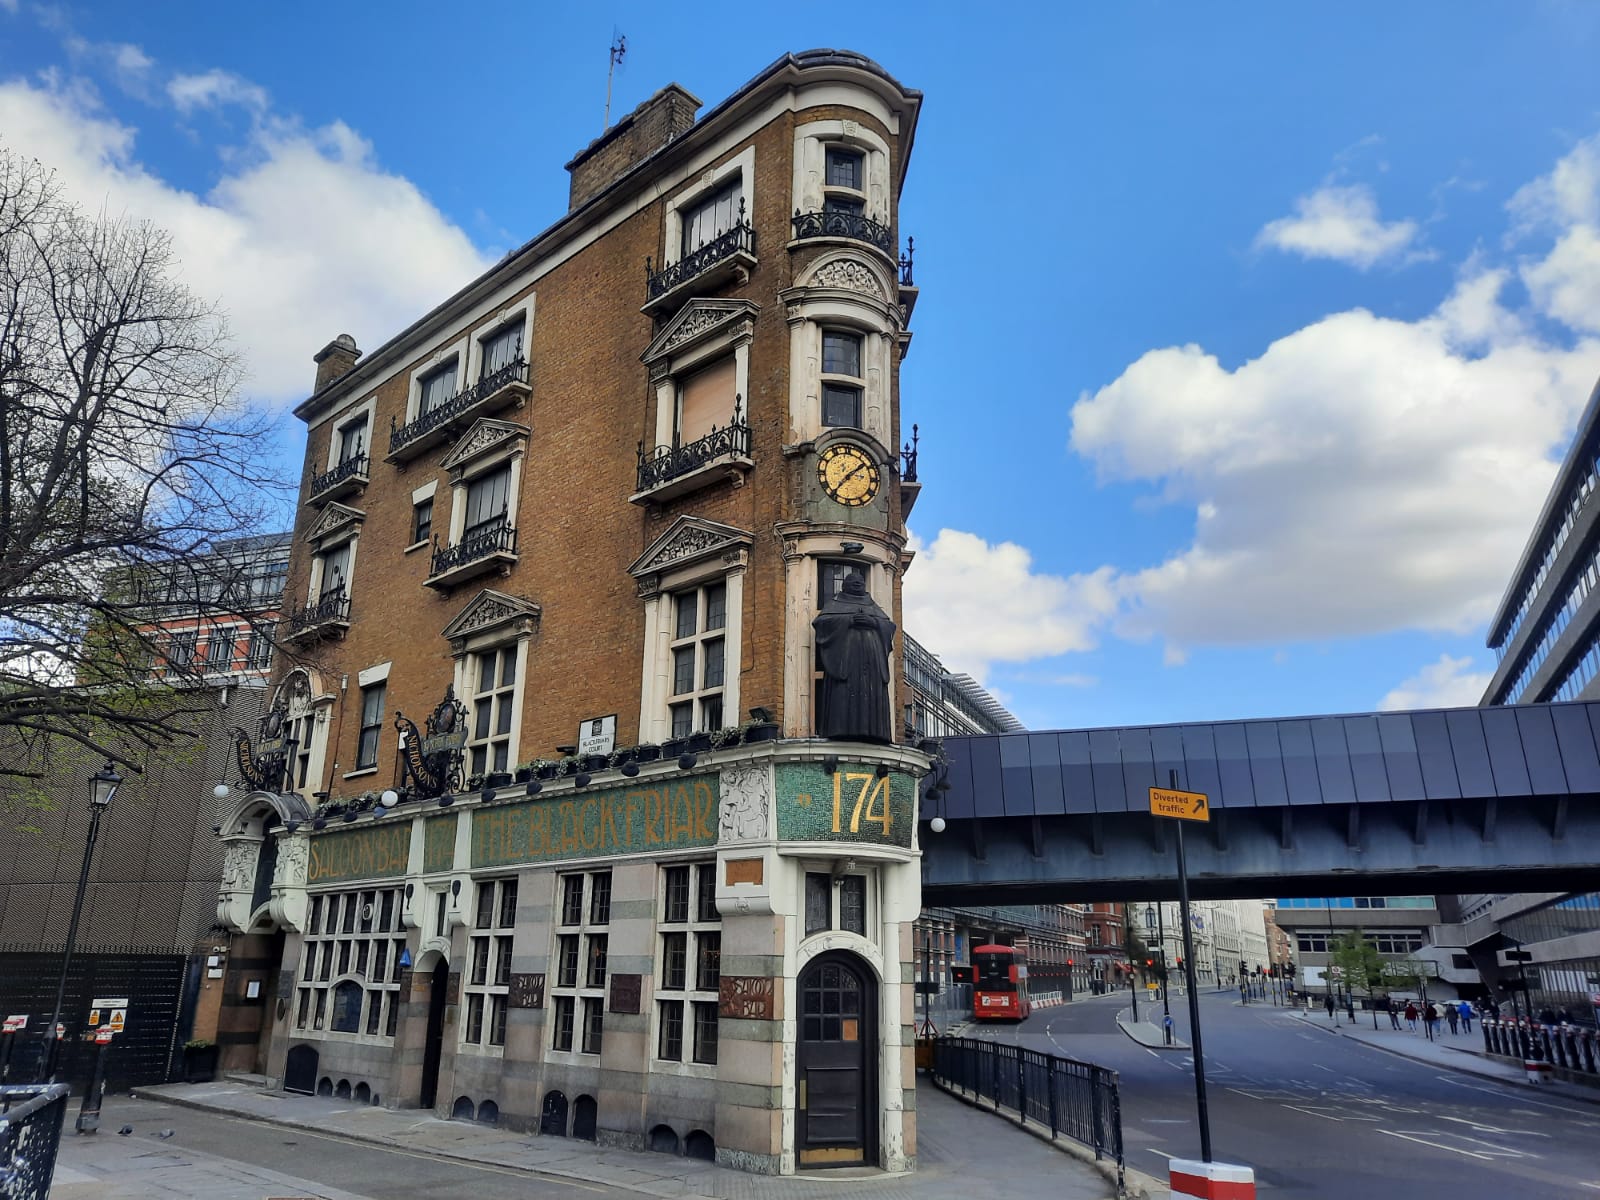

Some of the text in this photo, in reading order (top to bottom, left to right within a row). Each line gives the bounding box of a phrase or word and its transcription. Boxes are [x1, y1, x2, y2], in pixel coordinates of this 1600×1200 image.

[474, 781, 714, 861] THE BLACK FRIAR
[831, 772, 894, 837] 174
[1153, 792, 1189, 804] Diverted
[1159, 803, 1185, 814] traffic
[308, 831, 374, 880] SALOON
